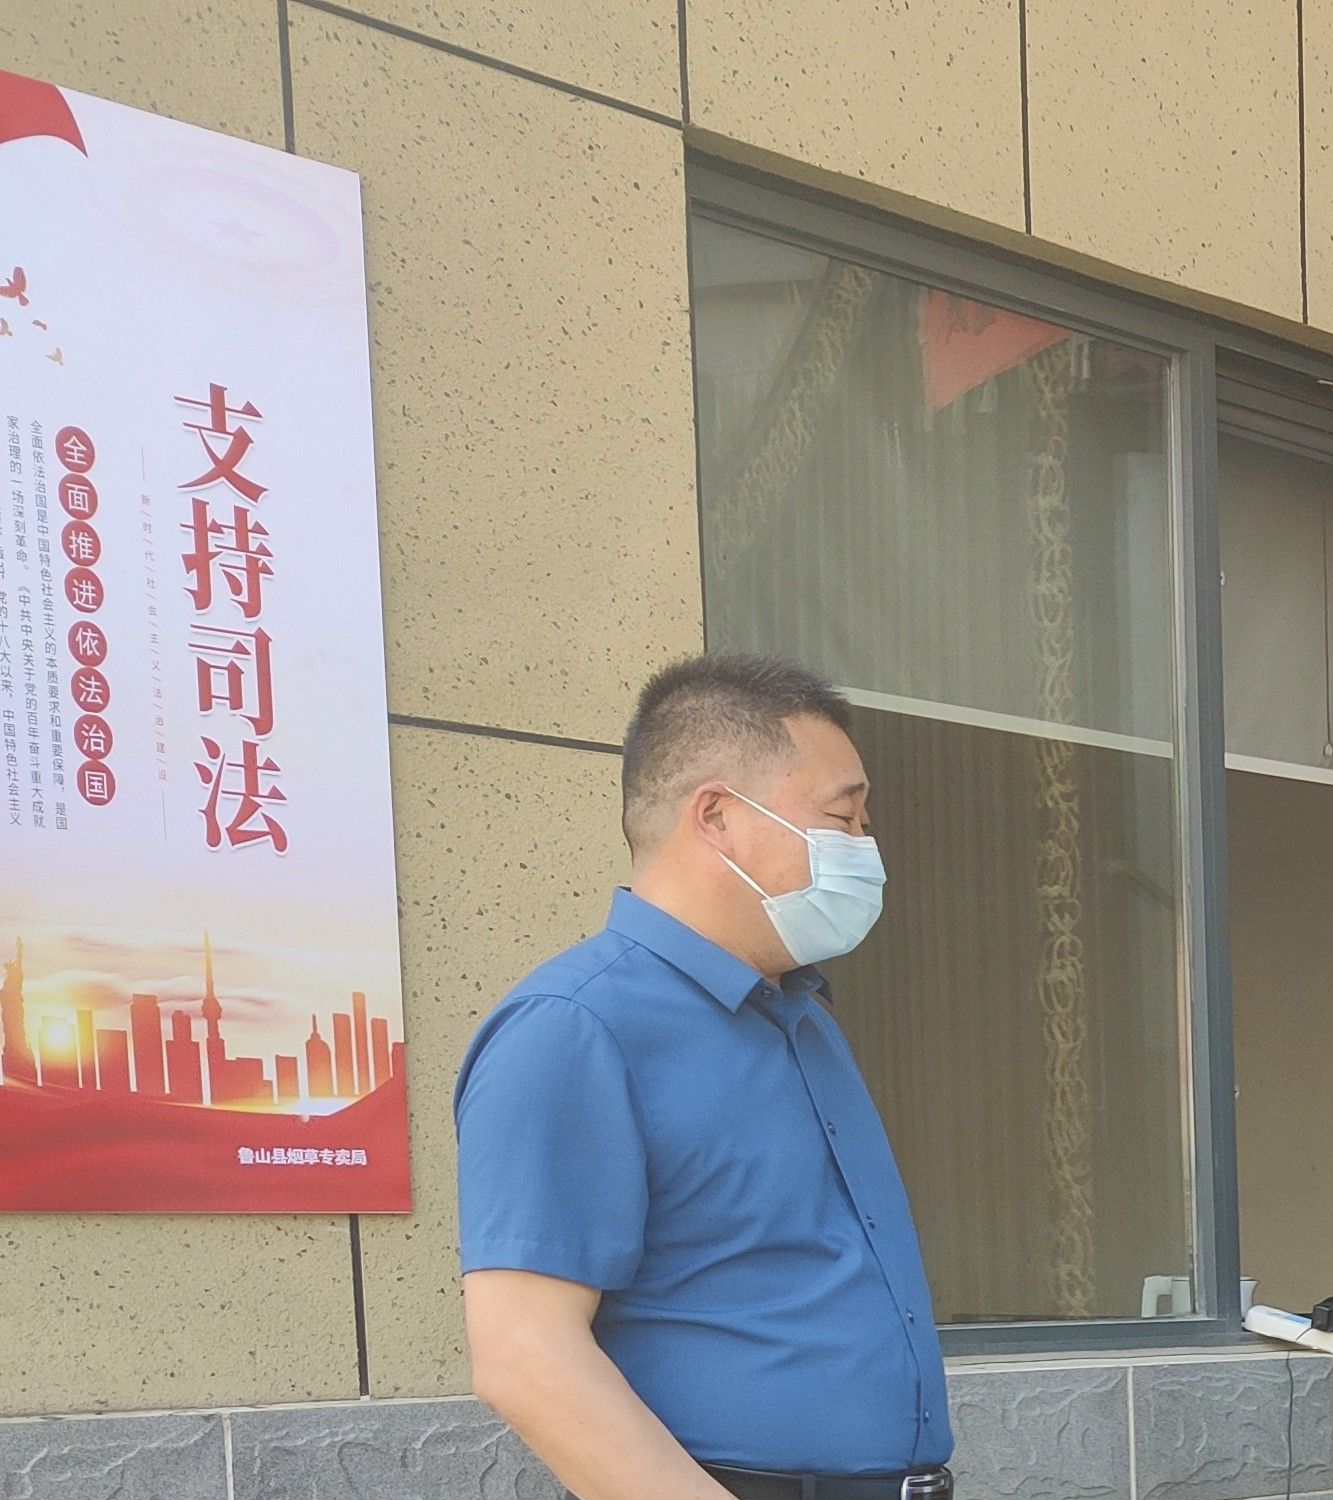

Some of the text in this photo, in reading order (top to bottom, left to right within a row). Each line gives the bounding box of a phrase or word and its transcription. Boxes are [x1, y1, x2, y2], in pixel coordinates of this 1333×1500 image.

[62, 434, 110, 801] 全面推进依法治国
[173, 382, 289, 854] 支持司法
[237, 1146, 367, 1166] 鲁山县烟草专卖局
